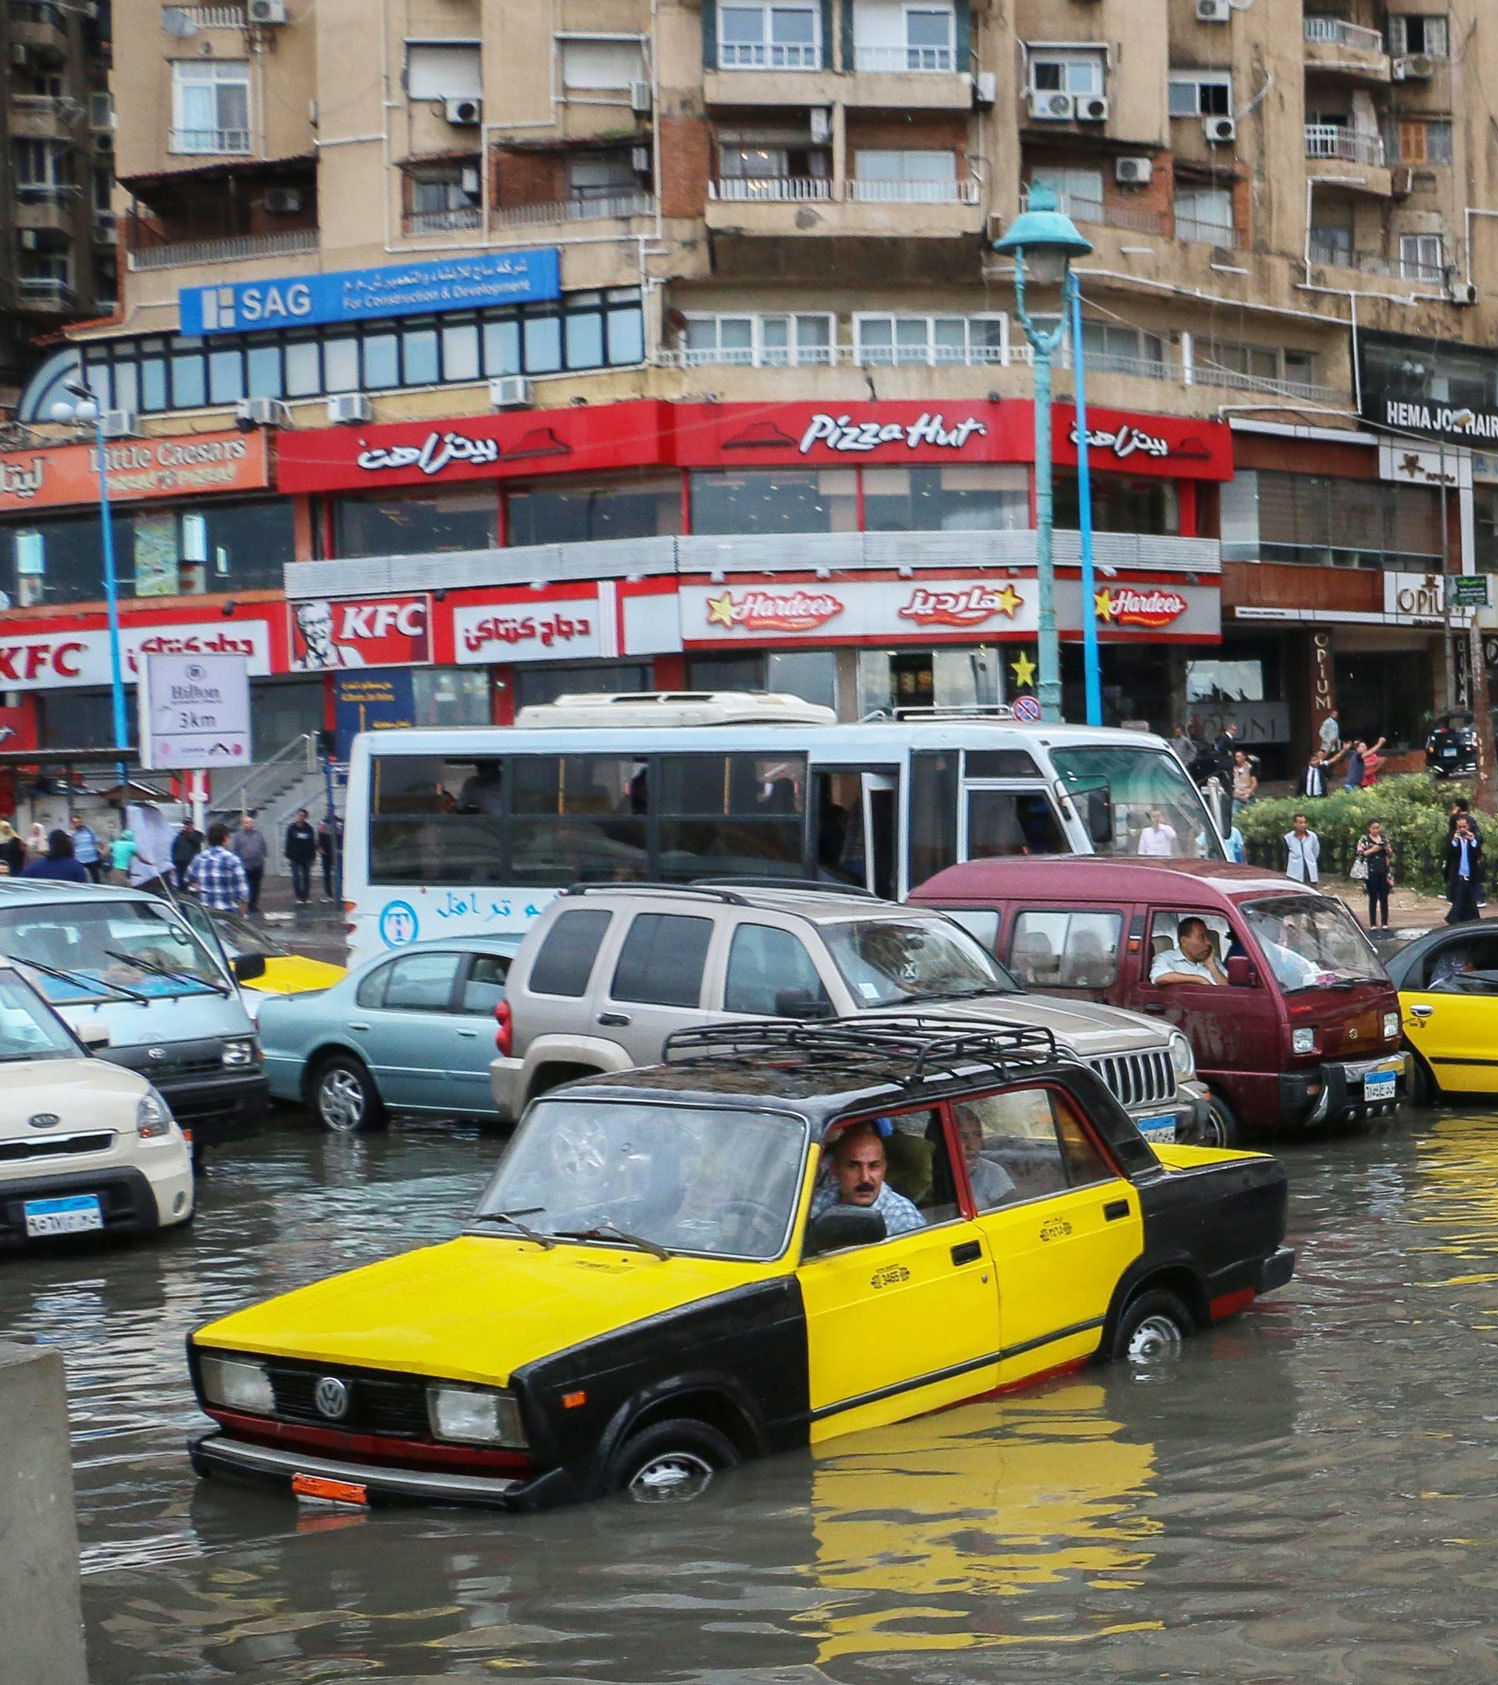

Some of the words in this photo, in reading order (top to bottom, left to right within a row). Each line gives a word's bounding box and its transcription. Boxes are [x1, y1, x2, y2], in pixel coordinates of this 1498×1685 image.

[242, 284, 311, 321] SAG
[365, 289, 439, 307] Construction
[441, 286, 451, 299] &
[453, 279, 531, 298] Development
[1387, 400, 1432, 430] HEMA
[799, 414, 904, 455] Pizza
[906, 412, 986, 449] Hut
[88, 446, 151, 472] Little
[157, 439, 246, 467] Caesars
[339, 602, 427, 640] KFC
[0, 642, 89, 680] KFC
[171, 685, 221, 700] Hilton
